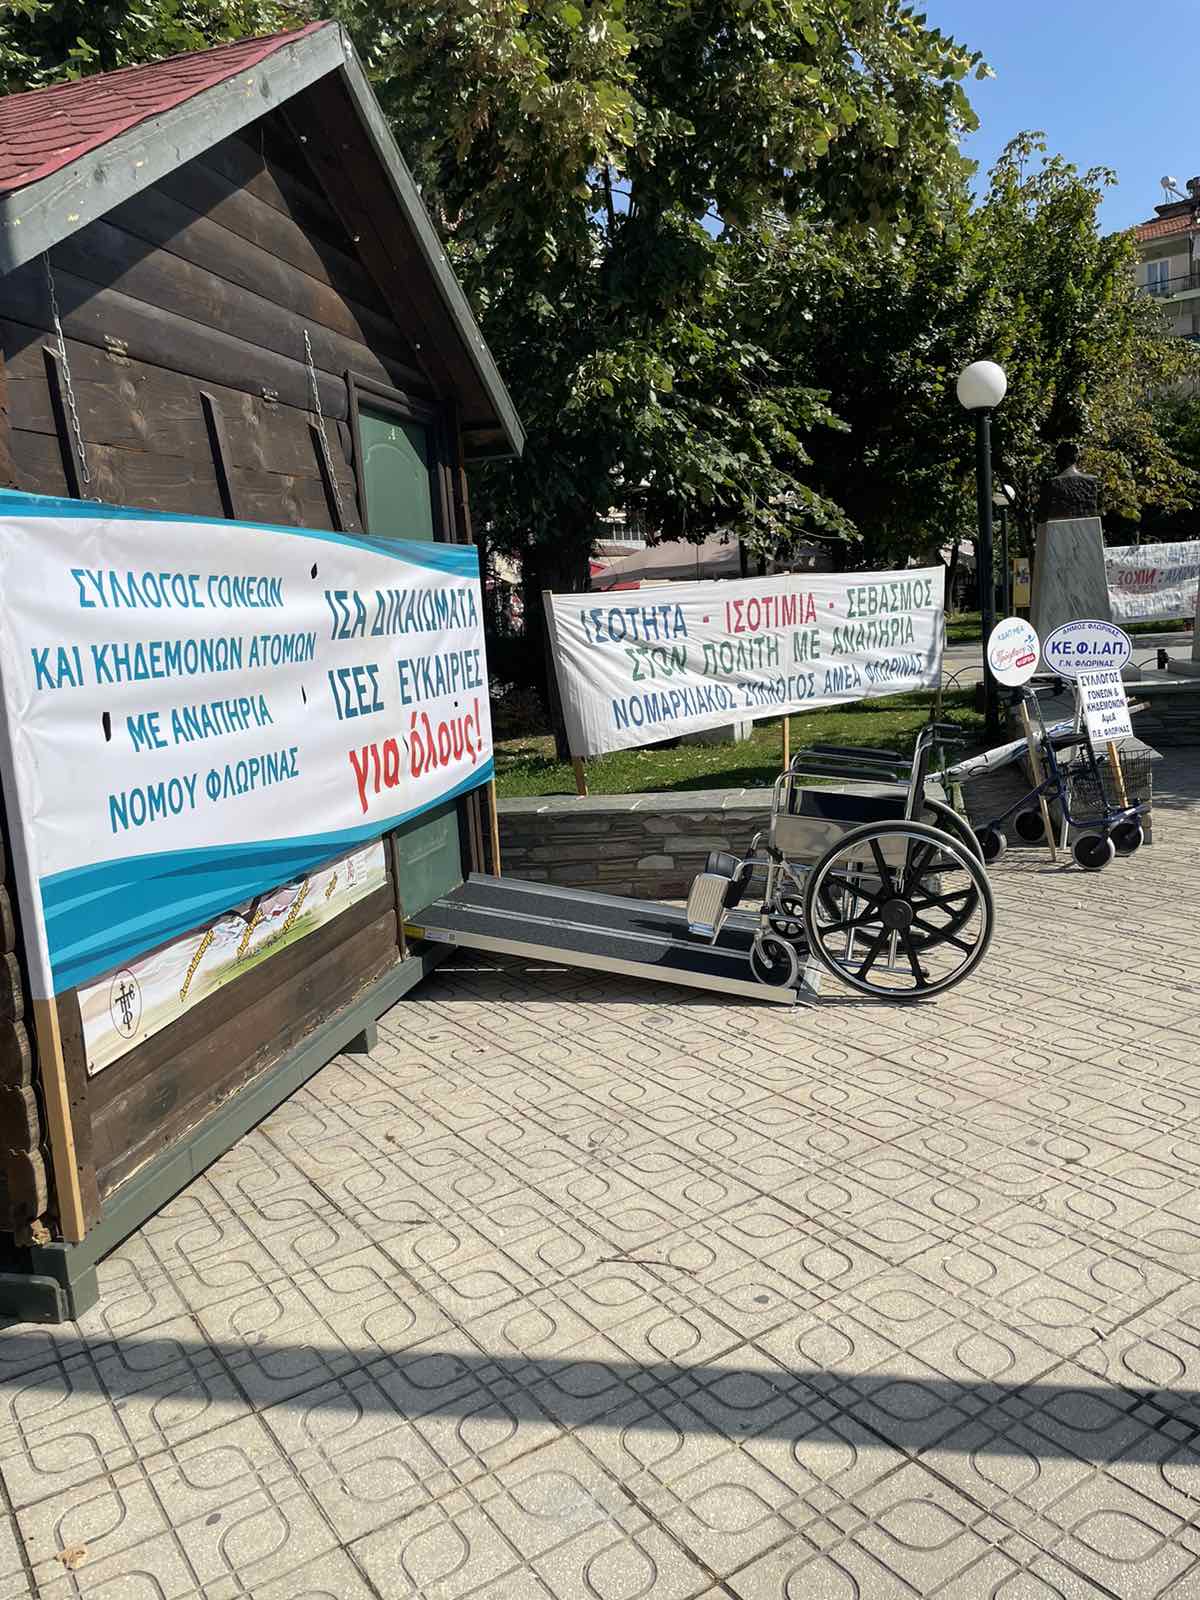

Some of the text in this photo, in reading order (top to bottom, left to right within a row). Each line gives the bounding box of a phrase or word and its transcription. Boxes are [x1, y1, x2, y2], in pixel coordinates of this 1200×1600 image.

[70, 568, 284, 608] ΣΥΛΛΟΓΟΣ ΓΟΝΕΩΝ
[324, 588, 479, 640] ΙΣΑ ΔΙΚΑΙΩΜΑΤΑ
[580, 579, 932, 643] ΙΣΟΤΗΤΑ ΙΣΟΤΙΜΙΑ ΣΕΒΑΣΜΟΣ
[31, 631, 316, 691] ΚΑΙ ΚΗΔΕΜΟΝΩΝ ΑΤΟΜΩΝ
[624, 615, 915, 682] ΣΤΟΝ ΠΟΛΙΤΗ ΜΕ ΑΝΑΠΗΡΙΑ
[1051, 641, 1127, 655] ΚΕ.Φ.Ι.ΑΠ.
[1075, 658, 1114, 668] ΦΛΩΡΙΝΑΣ
[327, 648, 483, 721] ΙΣΕΣ ΕΥΚΑΙΡΙΕΣ
[612, 653, 924, 730] ΝΟΜΑΡΧΙΑΚΟΣ ΣΥΛΛΟΓΟΣ ΑΜΕΑ ΦΛΩΡΙΝΑΣ
[1080, 672, 1120, 687] ΣΥΛΛΟΓΟΣ
[1087, 688, 1113, 700] ΓΟΝΕΩΝ
[1087, 698, 1125, 712] ΚΗΔΕΜΟΝΩΝ
[126, 694, 273, 752] ΜΕ ΑΝΑΠΗΡΙΑ
[349, 698, 483, 814] για όλους!
[109, 747, 299, 834] ΝΟΜΟΥ ΦΛΩΡΙΝΑΣ
